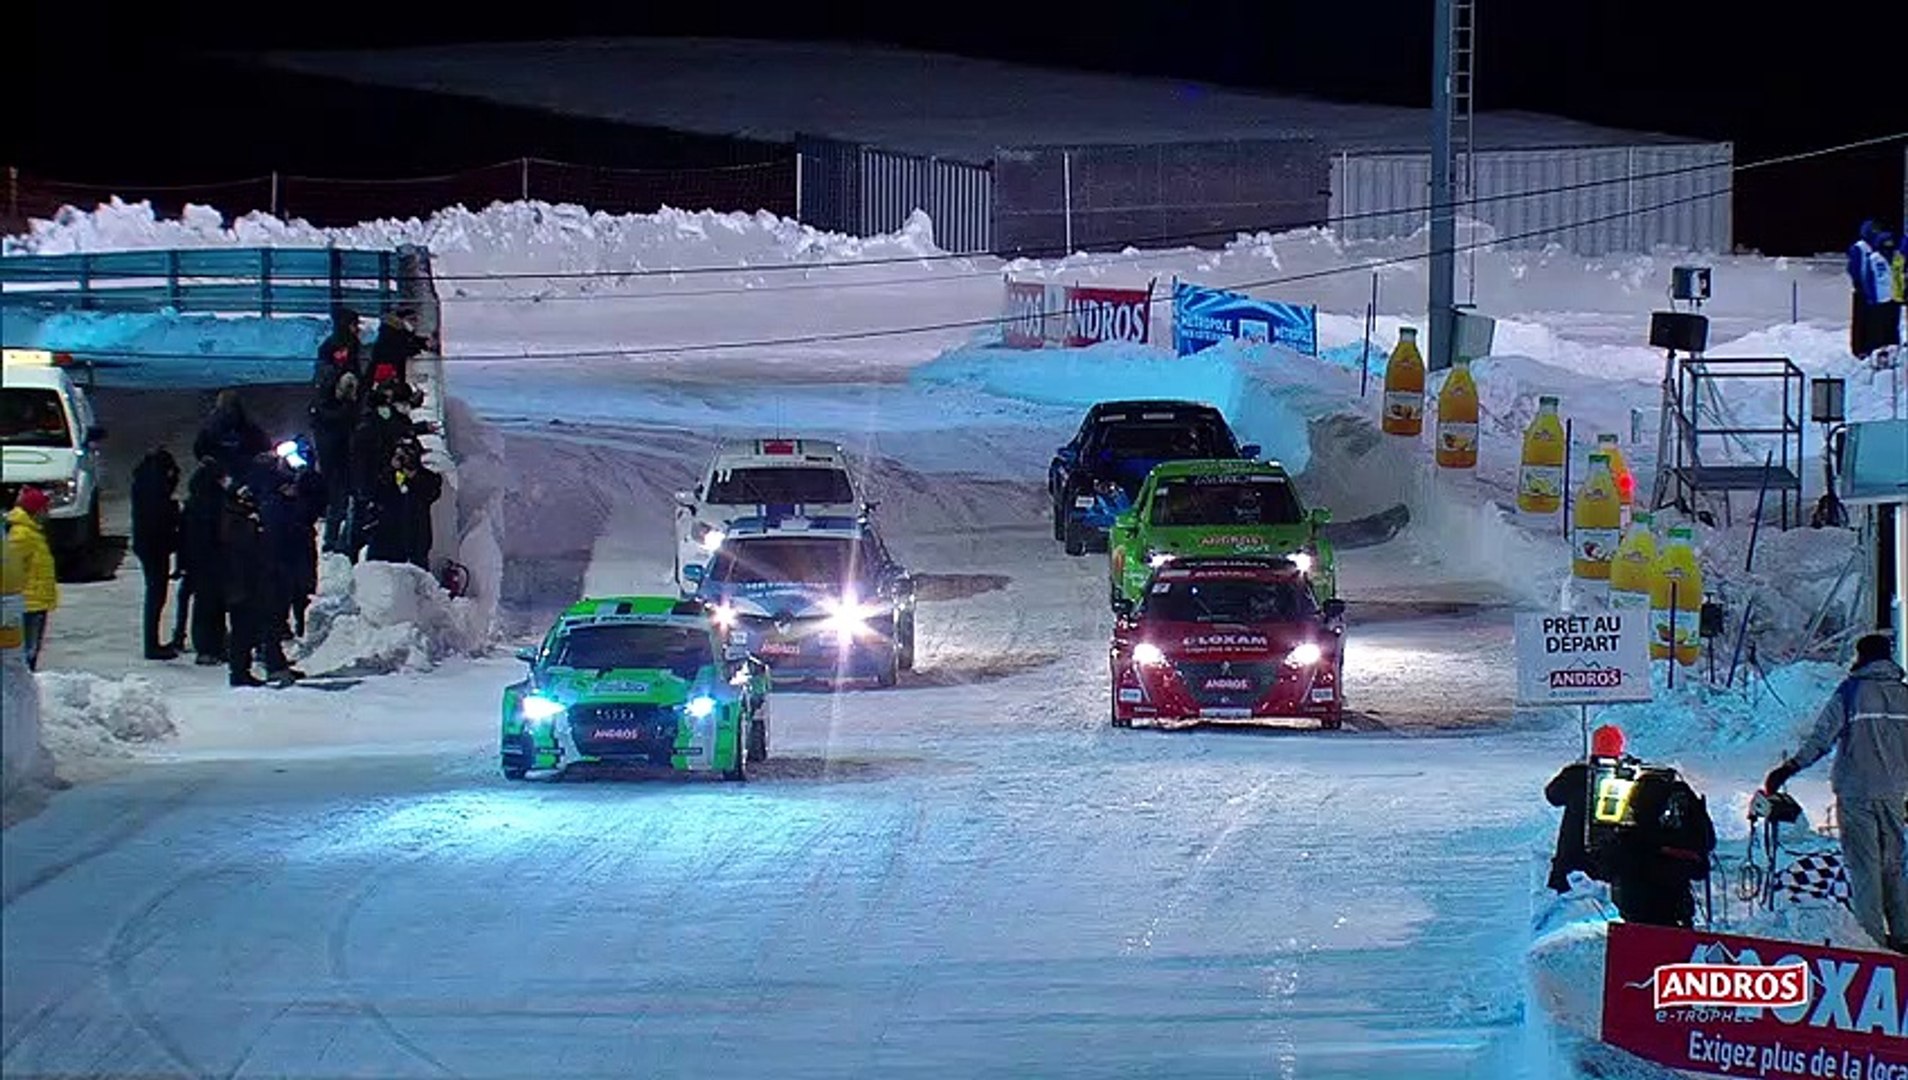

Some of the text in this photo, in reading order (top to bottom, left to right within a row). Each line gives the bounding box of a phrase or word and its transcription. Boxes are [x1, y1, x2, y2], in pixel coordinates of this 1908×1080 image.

[1064, 299, 1145, 341] ANDROS
[1543, 614, 1622, 633] PRÊT AU
[1198, 636, 1268, 645] LOXAM
[1546, 633, 1621, 653] DÉPART
[1552, 671, 1619, 686] ANDROS
[1688, 1030, 1757, 1071] Exigez
[1760, 1041, 1806, 1075] plus
[1811, 1046, 1837, 1078] de
[1842, 1050, 1862, 1080] la
